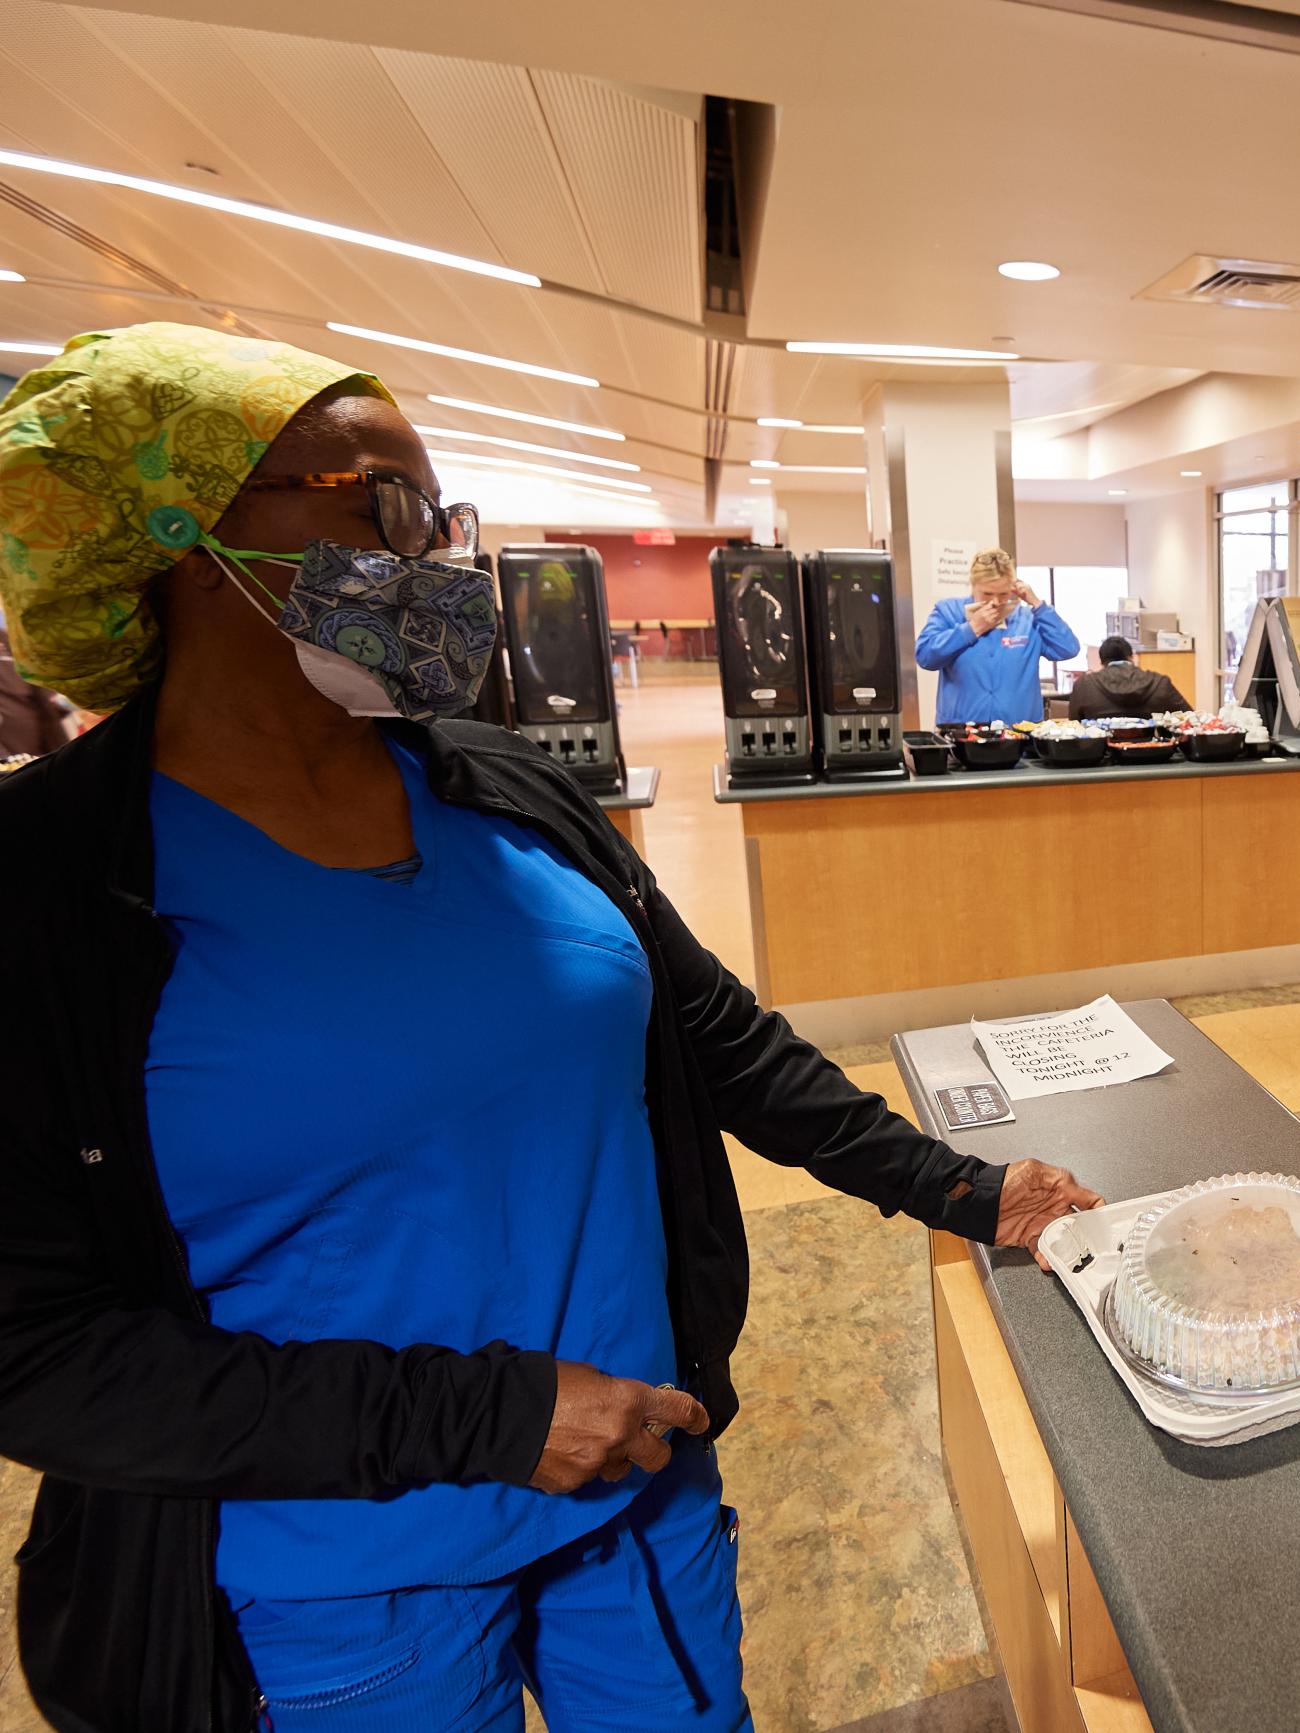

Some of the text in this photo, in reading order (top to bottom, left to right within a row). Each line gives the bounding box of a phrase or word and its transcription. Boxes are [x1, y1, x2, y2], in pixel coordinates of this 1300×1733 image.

[990, 1013, 1099, 1039] SORRY FOR THE
[1000, 1028, 1115, 1053] THE CAFETERIA
[1005, 1045, 1067, 1059] WILL BE
[1011, 1052, 1077, 1066] CLOSING
[1017, 1052, 1131, 1075] TONIGHT @ 12
[1033, 1065, 1113, 1082] MIDNIGHT
